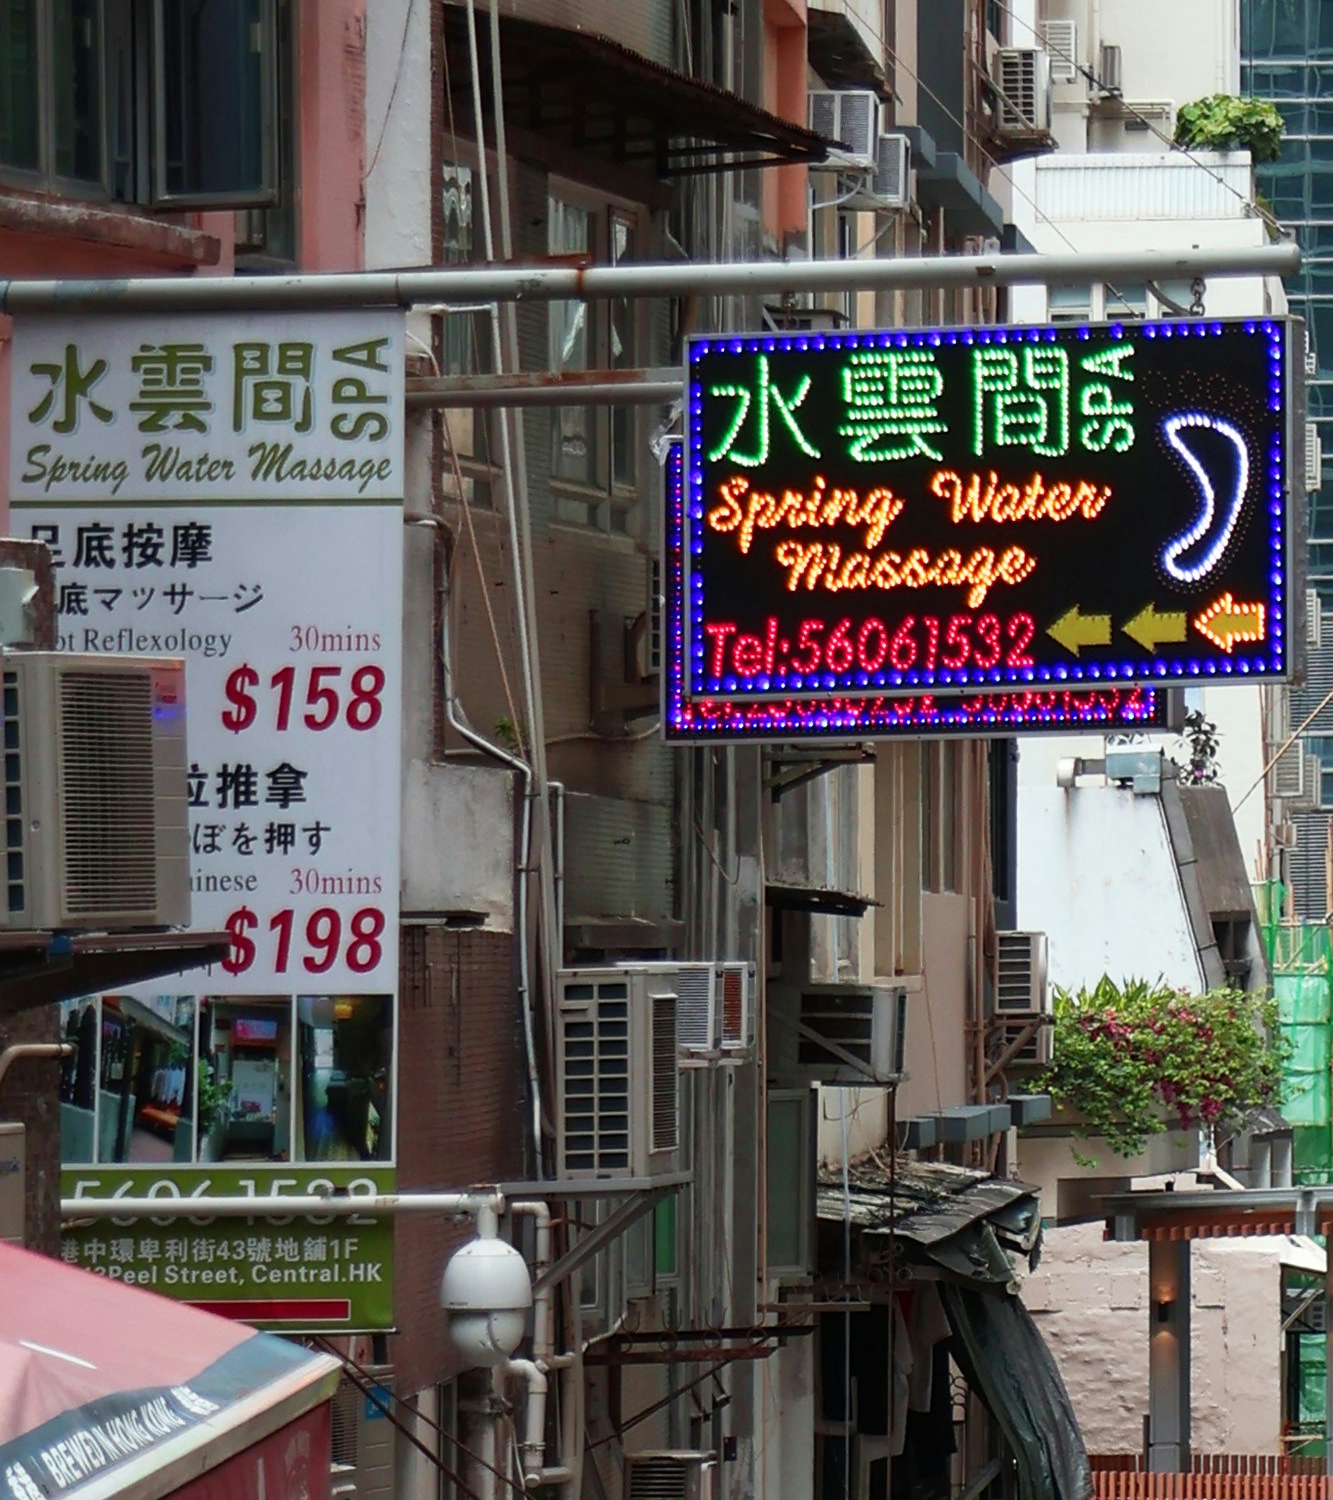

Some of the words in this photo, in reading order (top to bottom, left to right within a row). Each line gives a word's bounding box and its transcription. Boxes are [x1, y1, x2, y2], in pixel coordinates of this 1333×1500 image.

[27, 342, 315, 436] 水雲間
[329, 337, 390, 442] SPA
[708, 347, 1070, 467] 水雲間
[1080, 343, 1136, 454] SPA
[21, 443, 131, 495] Spring
[140, 443, 237, 484] Water
[247, 441, 393, 494] Massage
[707, 476, 904, 554] Spring
[930, 469, 1112, 524] Water
[776, 540, 1036, 609] Massage
[84, 627, 233, 656] Reflexology
[288, 625, 382, 653] 30mins
[221, 662, 387, 735] $158
[289, 867, 383, 896] 30mins
[220, 905, 387, 977] $198
[164, 1264, 245, 1286] Street,
[105, 1408, 154, 1454] HONG
[140, 1395, 187, 1436] KONG
